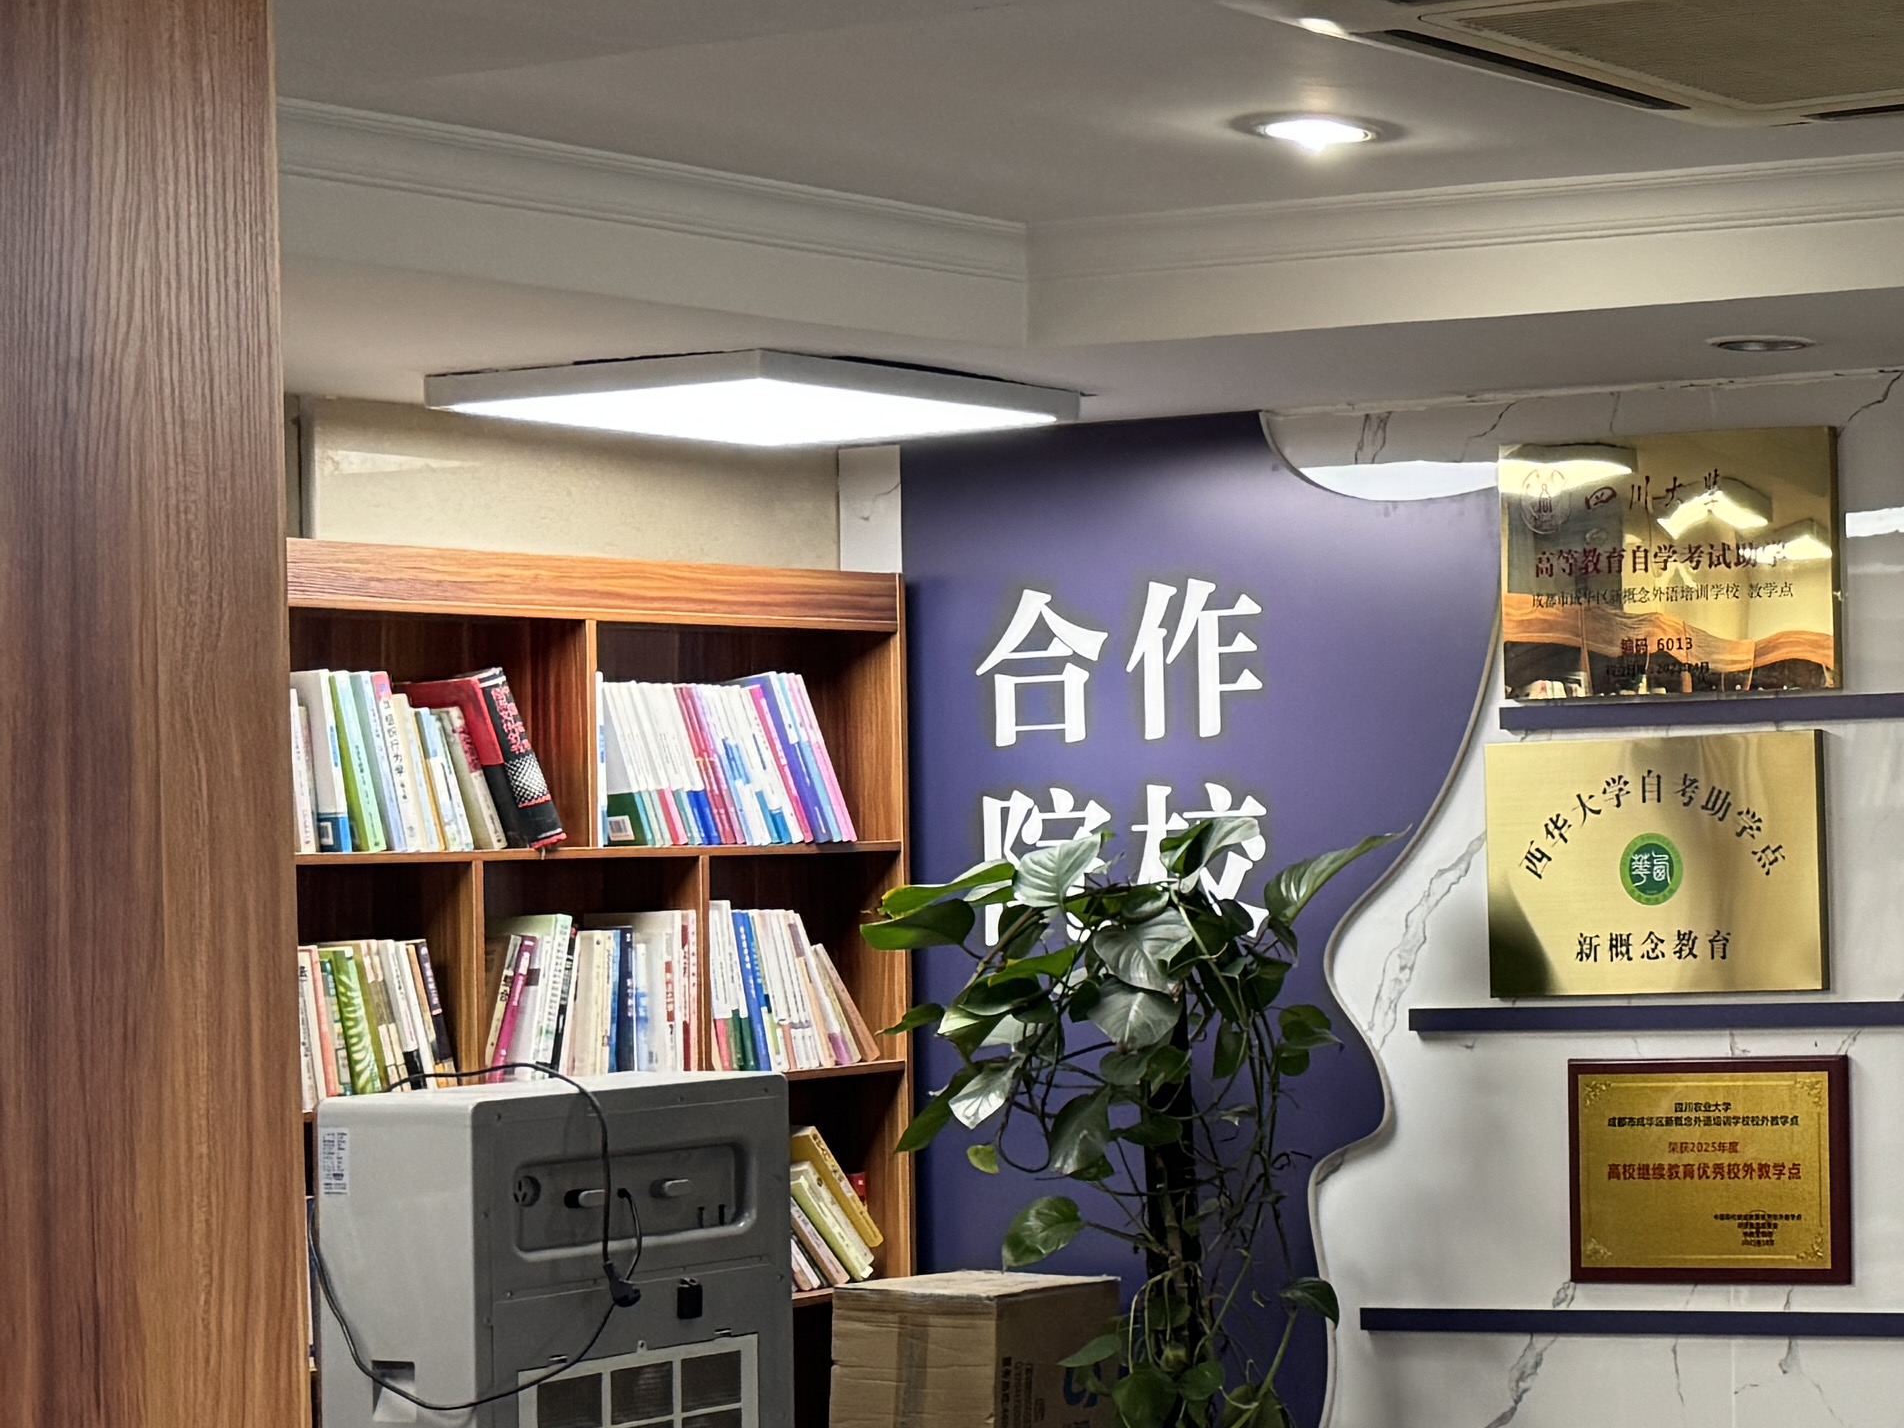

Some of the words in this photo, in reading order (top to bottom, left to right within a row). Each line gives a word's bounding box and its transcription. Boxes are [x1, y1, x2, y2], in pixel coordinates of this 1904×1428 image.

[1535, 541, 1785, 577] 高等教育自学考试助学
[1657, 637, 1693, 652] 6013
[976, 578, 1263, 747] 合作
[1519, 769, 1786, 879] 西华大学自考助学点
[1575, 929, 1731, 963] 新概念教育
[1668, 1141, 1740, 1154] 荣获2025年度
[1607, 1162, 1802, 1181] 高校继续教育优秀校外教学点
